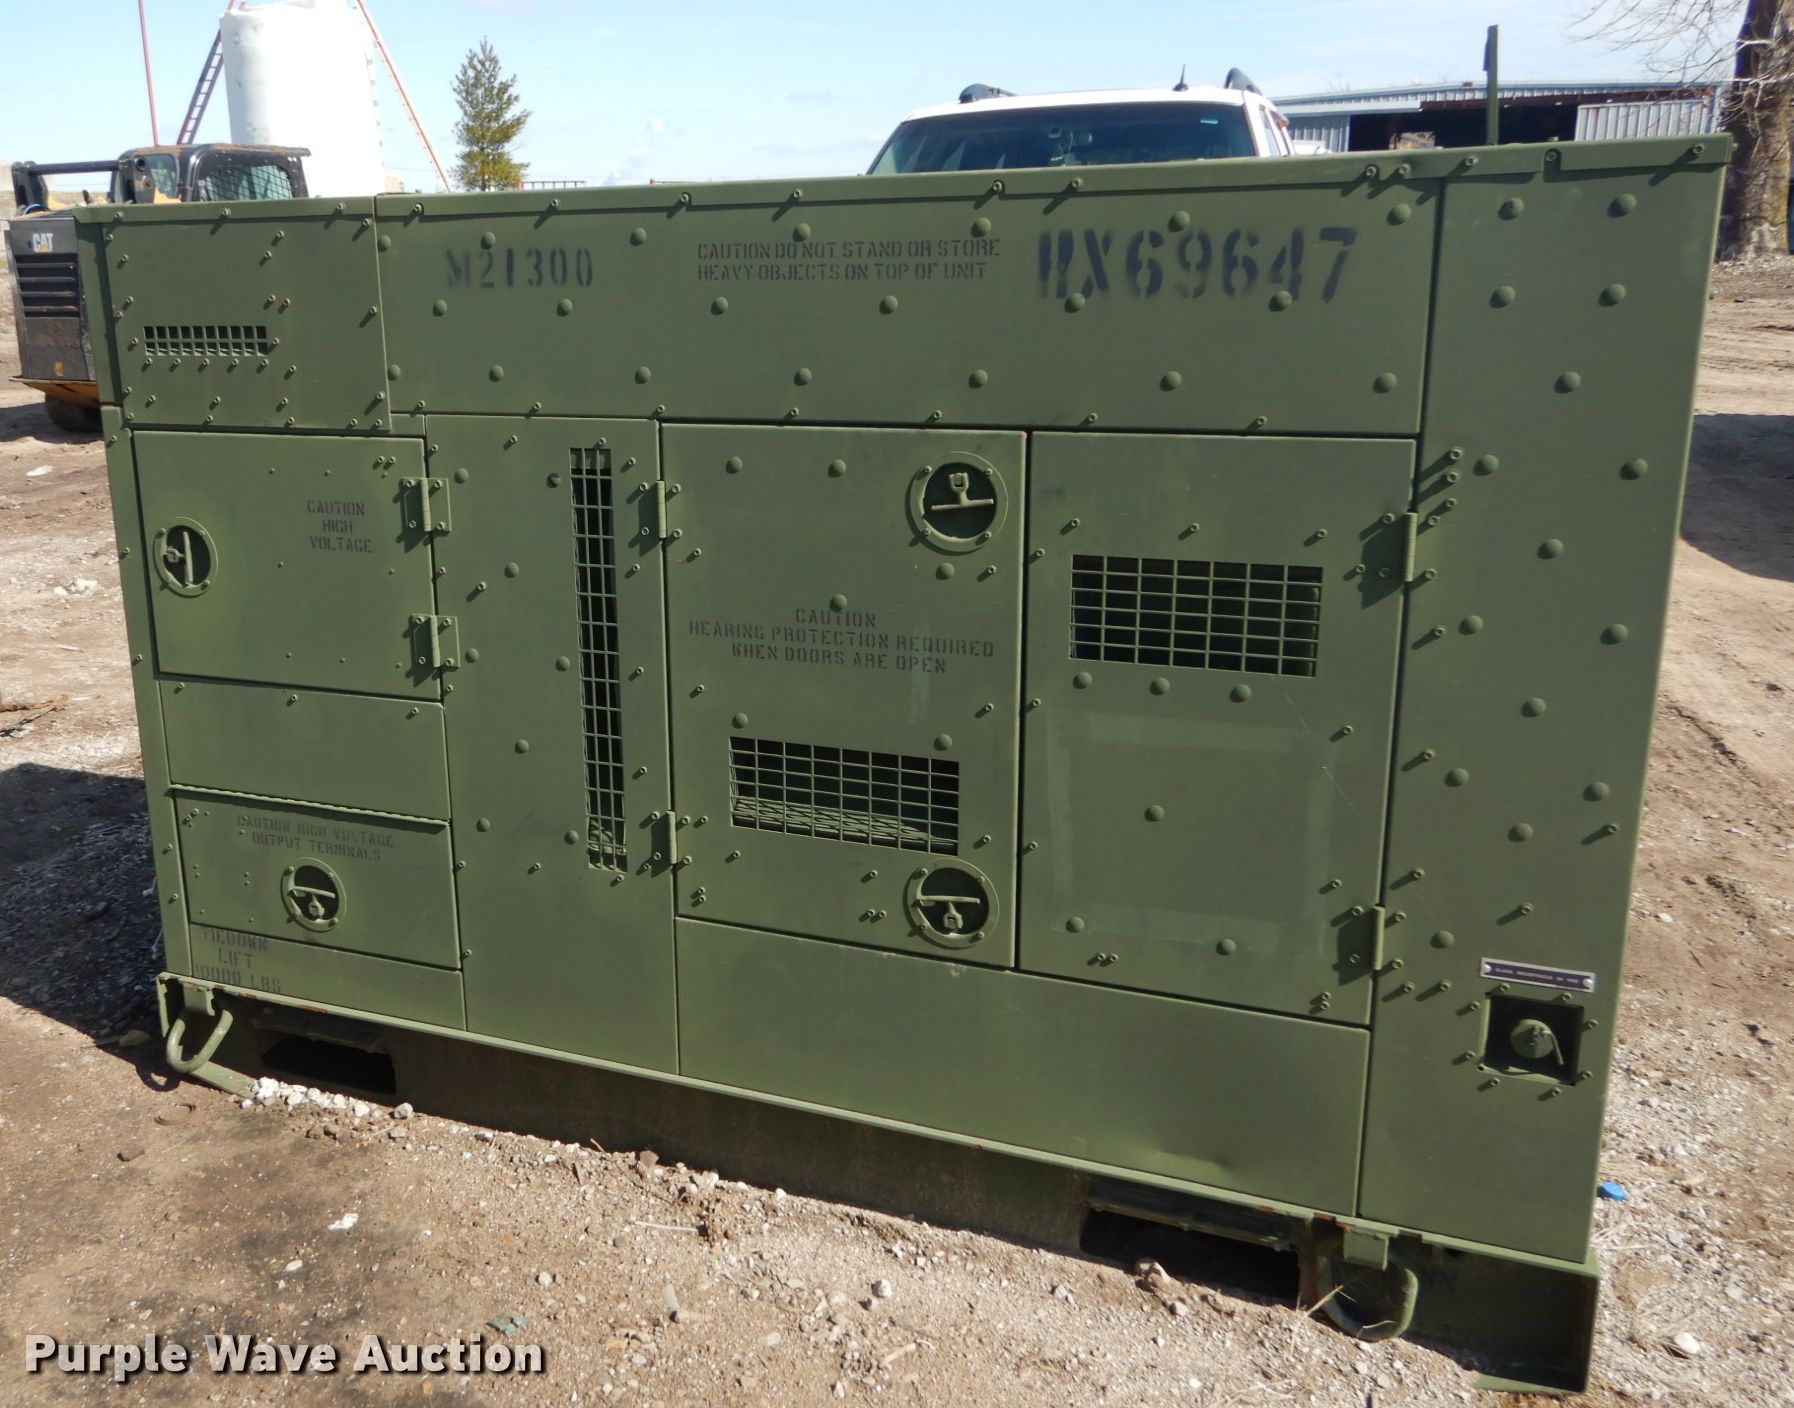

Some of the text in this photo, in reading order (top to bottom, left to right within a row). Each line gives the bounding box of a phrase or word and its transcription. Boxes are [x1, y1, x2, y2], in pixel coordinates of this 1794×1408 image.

[33, 232, 54, 253] CAT
[698, 238, 1001, 260] CAUTION DO NOT STAND OR STORE
[446, 248, 593, 289] M21300
[698, 262, 987, 281] HEAVY OBJECTS ON TOP OF UNIT
[306, 499, 366, 517] CAUTION
[322, 519, 353, 534] HIGH
[309, 535, 373, 553] VOLTAGE
[795, 607, 877, 629] CAUTION
[688, 619, 994, 658] HEARING PROTECTION REQUIRED
[731, 642, 946, 674] WHEN DOORS ARE OPEN
[237, 814, 394, 849] CAUTION HIGH VOLTAGE
[252, 831, 382, 862] OUTPUT TERMINALS
[218, 948, 253, 968] LIFT
[249, 973, 281, 993] LBS
